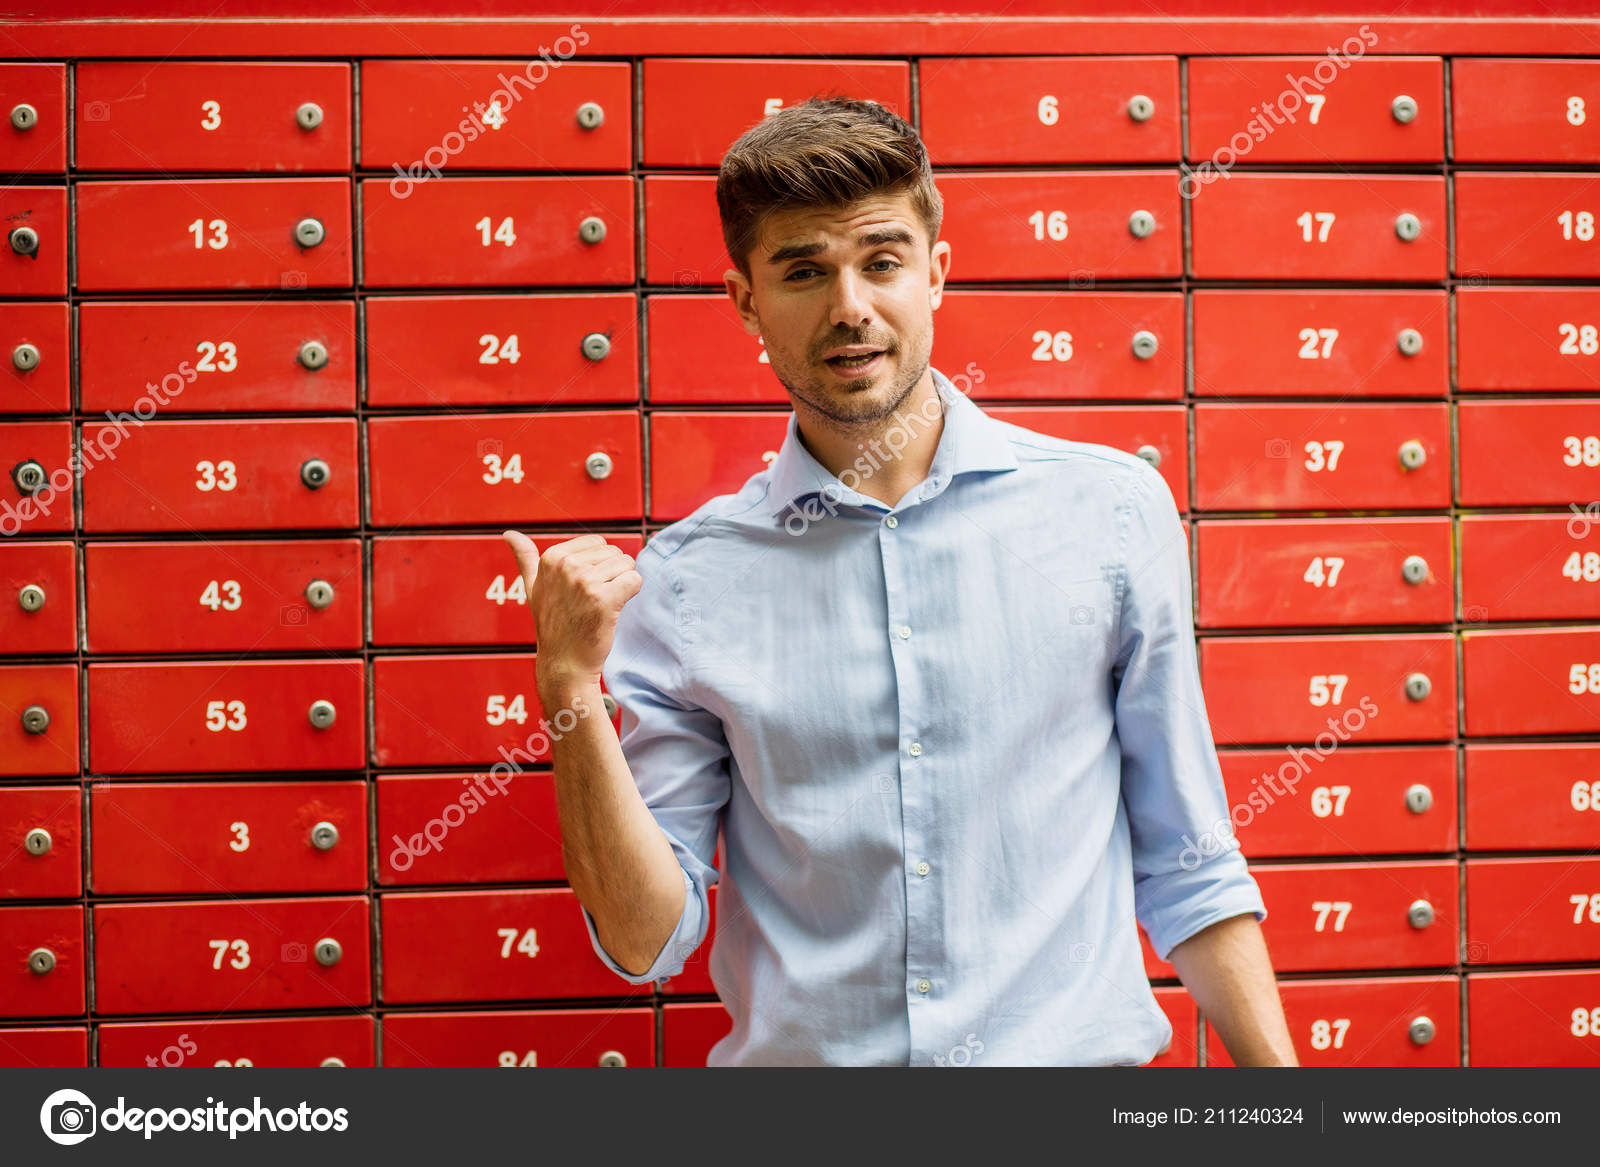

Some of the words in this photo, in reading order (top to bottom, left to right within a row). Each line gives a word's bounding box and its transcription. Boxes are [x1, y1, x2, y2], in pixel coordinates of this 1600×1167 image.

[201, 101, 221, 130] 3
[481, 100, 505, 130] 4
[1037, 95, 1059, 125] 6
[1304, 94, 1327, 125] 7
[1566, 96, 1586, 126] 8
[189, 219, 229, 249] 13
[476, 217, 516, 246] 14
[1028, 210, 1068, 241] 16
[1297, 212, 1336, 242] 17
[1557, 211, 1595, 241] 18
[479, 334, 521, 364] 24
[1031, 330, 1073, 362] 26
[1299, 328, 1339, 359] 27
[1559, 323, 1599, 355] 28
[196, 341, 237, 372] 23
[1305, 441, 1344, 472] 37
[1563, 436, 1600, 467] 38
[196, 461, 237, 491] 33
[483, 454, 524, 484] 34
[1303, 557, 1344, 587] 47
[1562, 552, 1600, 582] 48
[200, 581, 241, 610] 43
[486, 575, 527, 605] 44
[1309, 675, 1348, 706] 57
[1569, 664, 1600, 694] 58
[207, 701, 247, 731] 53
[487, 695, 527, 725] 54
[1311, 786, 1351, 817] 67
[230, 822, 249, 851] 3
[1312, 902, 1351, 932] 77
[1570, 894, 1600, 924] 78
[209, 940, 250, 969] 73
[498, 929, 539, 958] 74
[1311, 1019, 1350, 1049] 87
